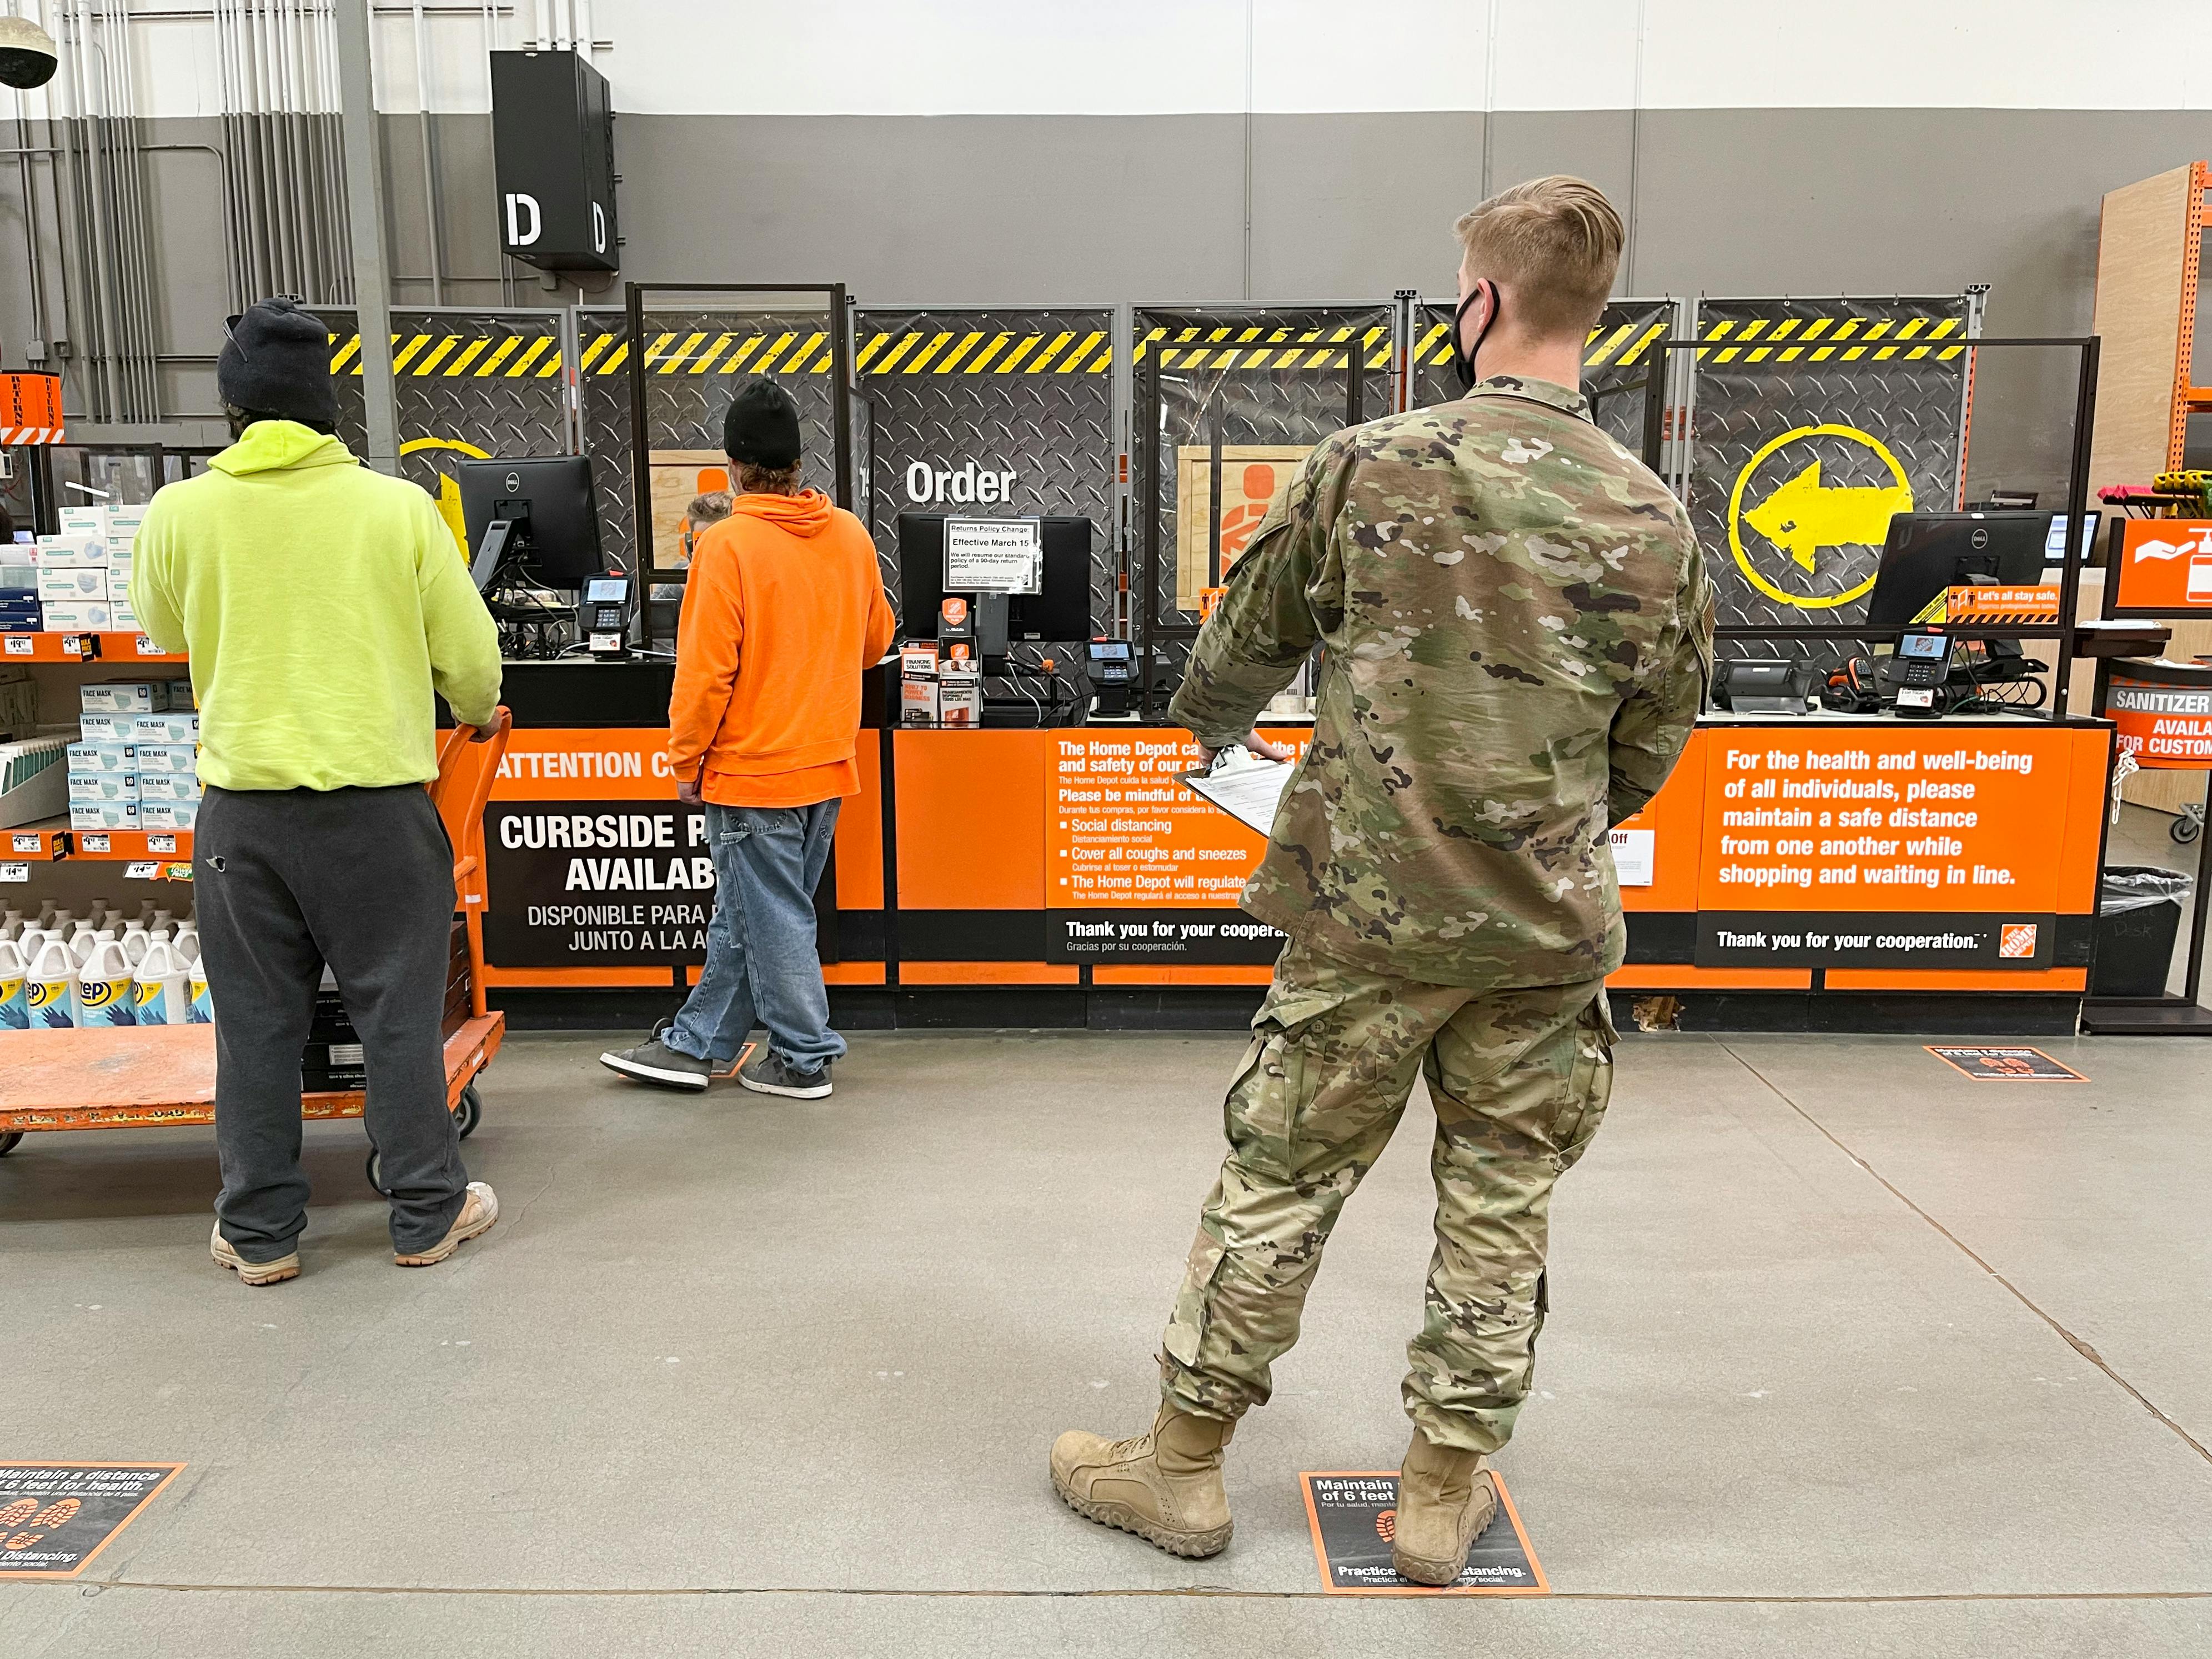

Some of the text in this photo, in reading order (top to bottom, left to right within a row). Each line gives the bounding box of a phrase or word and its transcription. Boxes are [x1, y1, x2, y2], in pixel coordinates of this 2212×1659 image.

[505, 193, 541, 245] D
[593, 201, 606, 254] D
[906, 462, 1017, 502] Order
[1978, 591, 2057, 602] Let's all stay safe.
[2116, 690, 2210, 713] SANITIZER
[1059, 741, 1085, 755] The
[1090, 741, 1131, 755] Home
[1136, 741, 1177, 759] Depot
[2116, 734, 2143, 751] FOR
[495, 752, 641, 778] ATTENTION
[1059, 758, 1085, 772] and
[1090, 758, 1135, 775] safety
[1139, 758, 1154, 772] of
[1157, 761, 1181, 772] our
[1727, 750, 2033, 774] For the health and well-being
[1097, 776, 1118, 785] Depot
[1120, 776, 1139, 784] cuida
[1150, 776, 1169, 784] salud
[1059, 789, 1101, 801] Please
[1105, 789, 1121, 801] be
[1125, 789, 1174, 801] mindful
[1178, 789, 1191, 801] of
[1725, 779, 1975, 801] of all individuals, please
[1059, 805, 1087, 814] Durante
[1208, 805, 1215, 814] lo
[1723, 808, 1977, 827] maintain a safe distance
[500, 815, 675, 848] CURBSIDE
[1072, 819, 1172, 833] Social distancing
[1611, 833, 1628, 844] Off
[1721, 835, 1962, 856] from one another while
[1072, 847, 1246, 863] Cover all coughs and sneezes
[565, 858, 719, 890] AVAILAB
[1719, 864, 2015, 888] shopping and waiting in line.
[1071, 875, 1246, 891] The Home Depot will regulate
[1111, 891, 1132, 900] Depot
[528, 905, 644, 925] DISPONIBLE
[651, 905, 705, 924] PARA
[1066, 921, 1290, 940] Thank you for your coopera
[569, 930, 687, 950] JUNTO A LA
[1067, 941, 1099, 951] Gracias
[1102, 943, 1116, 953] por
[1132, 941, 1187, 952] cooperación.
[1717, 931, 1978, 951] Thank you for your cooperation.
[85, 1470, 160, 1480] distance
[4, 1480, 144, 1491] 6 feet for health.
[1316, 1480, 1393, 1490] Maintain
[1322, 1491, 1396, 1501] of 6 feet
[1, 1551, 78, 1563] Distancing.
[1337, 1566, 1397, 1576] Practice
